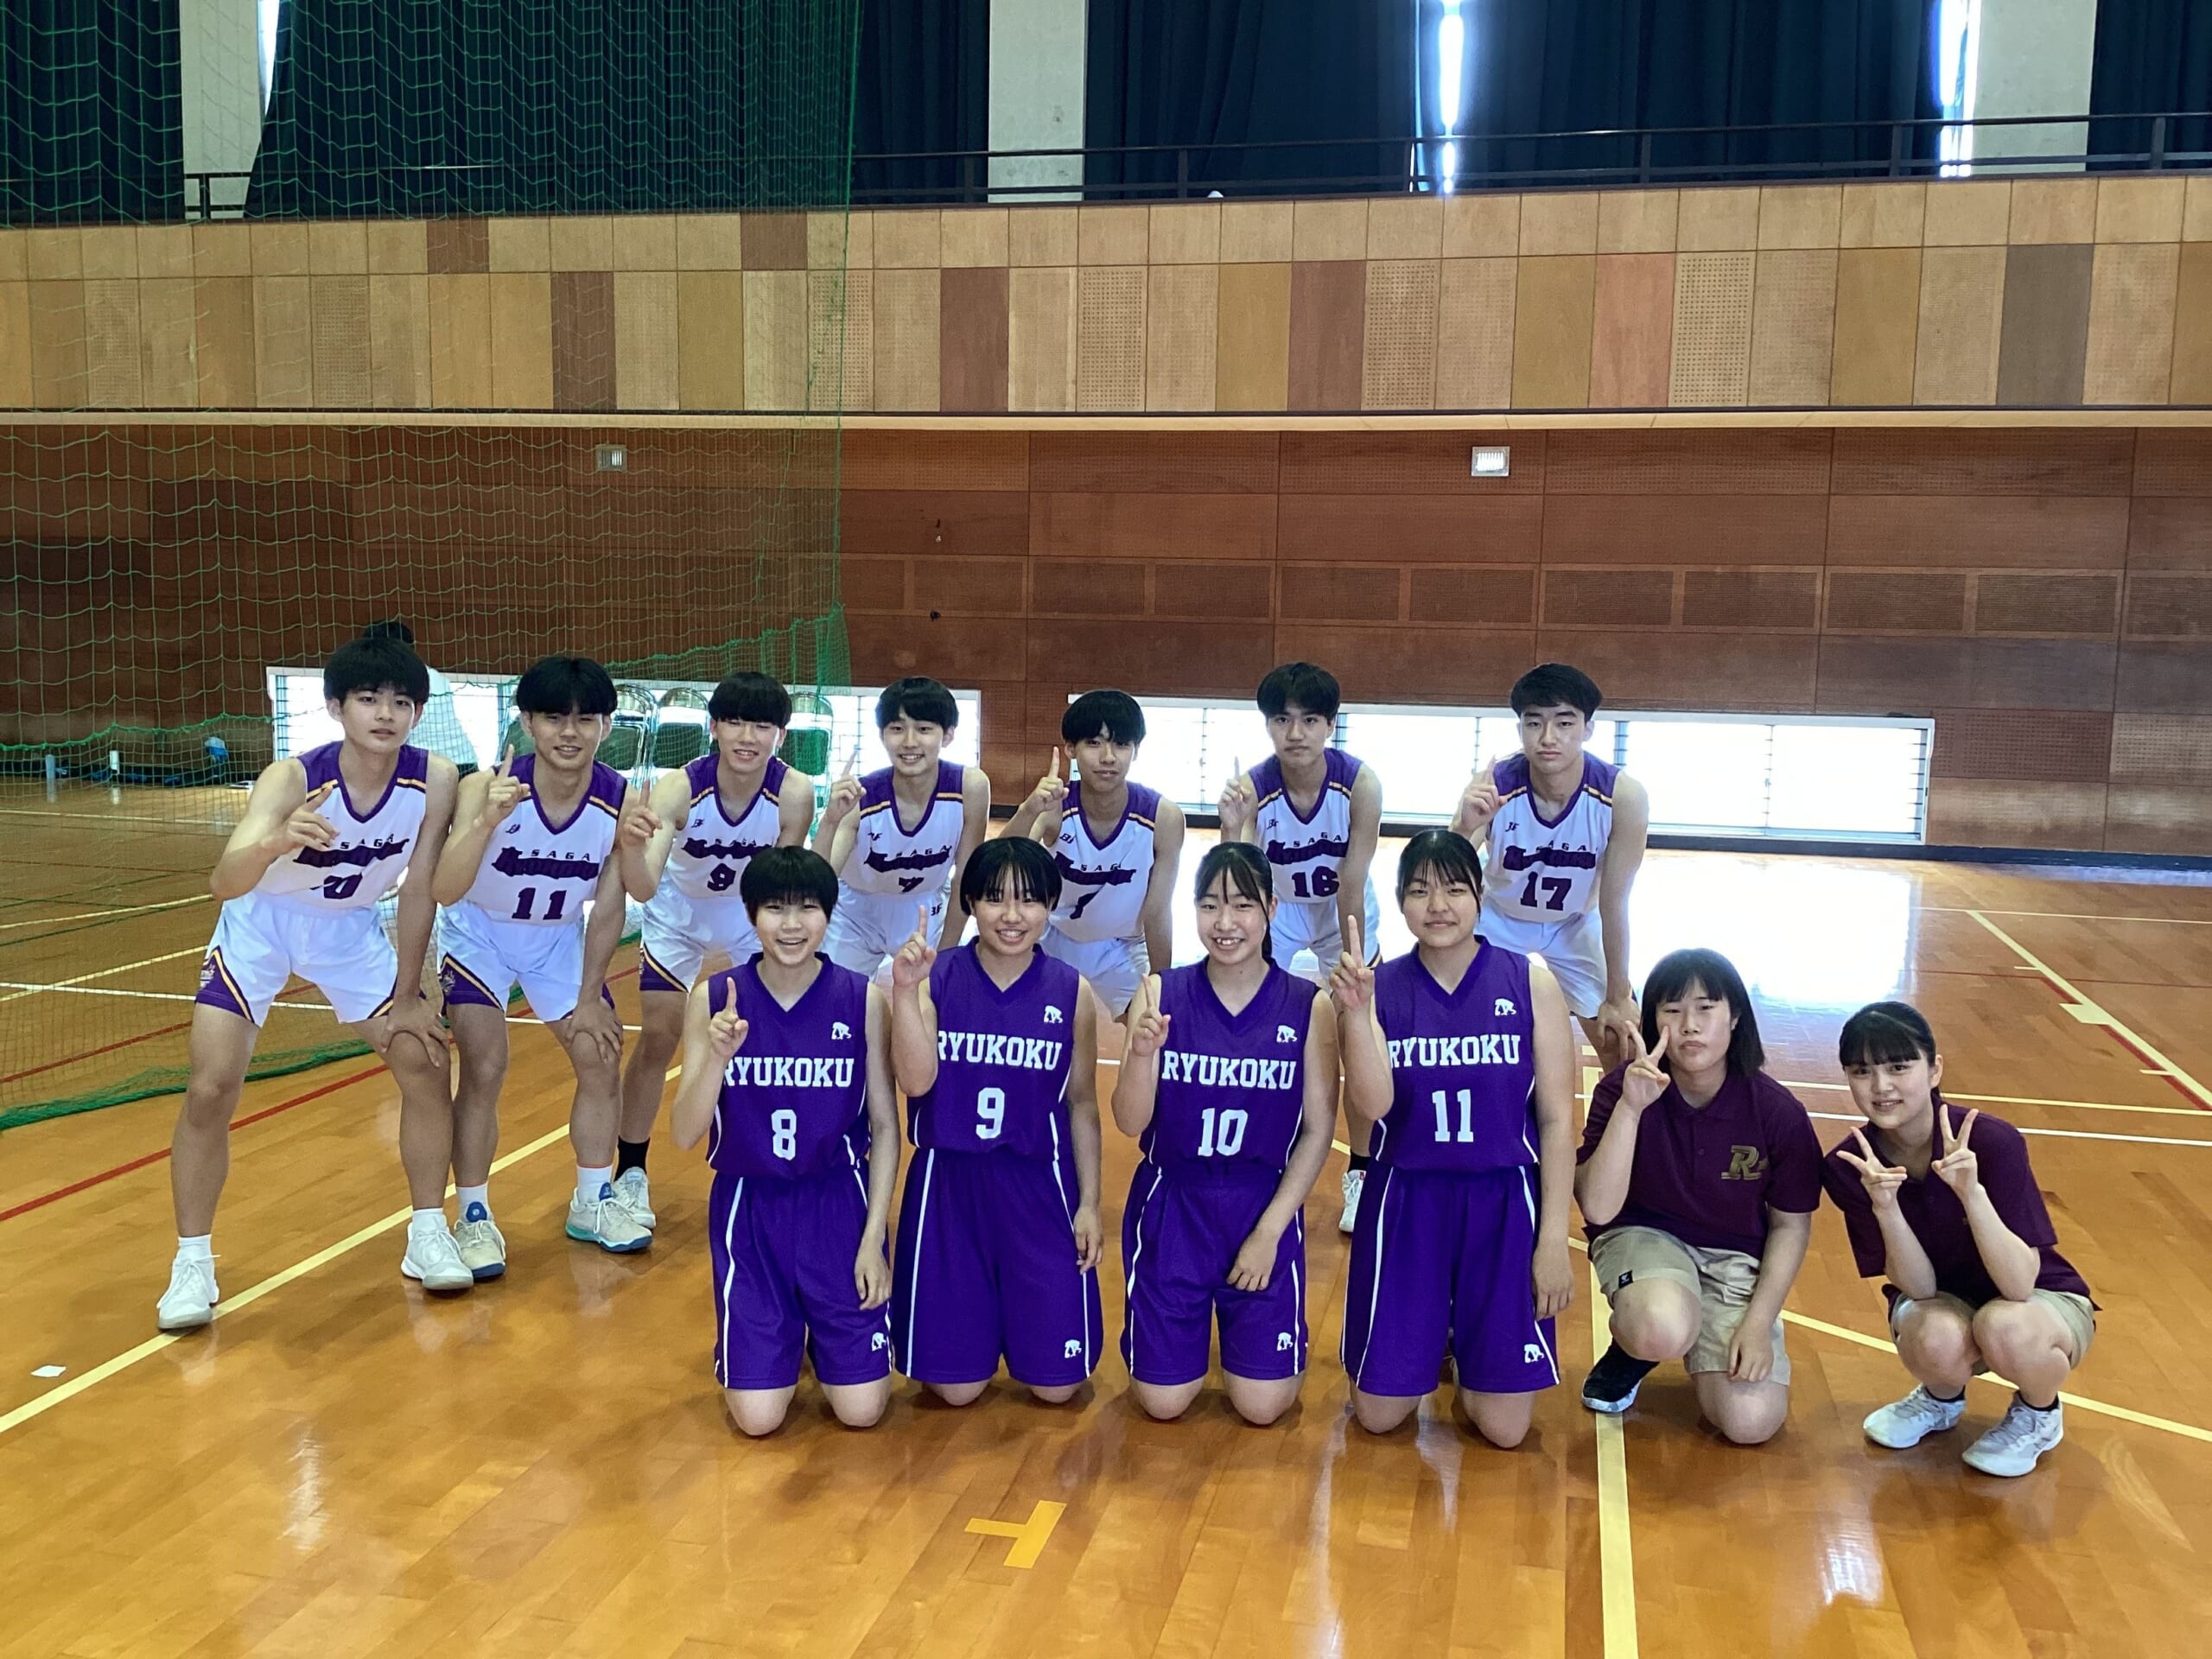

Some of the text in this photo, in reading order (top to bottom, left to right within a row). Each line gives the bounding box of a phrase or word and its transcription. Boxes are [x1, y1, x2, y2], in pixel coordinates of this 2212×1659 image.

[530, 849, 590, 861] SAGA
[512, 887, 567, 920] 11
[1520, 871, 1572, 911] 17
[938, 1030, 1063, 1071] RYUKOKU
[1161, 1050, 1297, 1090] RYUKOKU
[1386, 1033, 1521, 1069] RYUKOKU
[724, 1056, 855, 1088] RYUKOKU
[976, 1087, 1005, 1140] 9
[1198, 1108, 1249, 1157] 10
[1432, 1089, 1474, 1142] 11
[771, 1109, 797, 1160] 8
[1721, 1145, 1762, 1180] R
